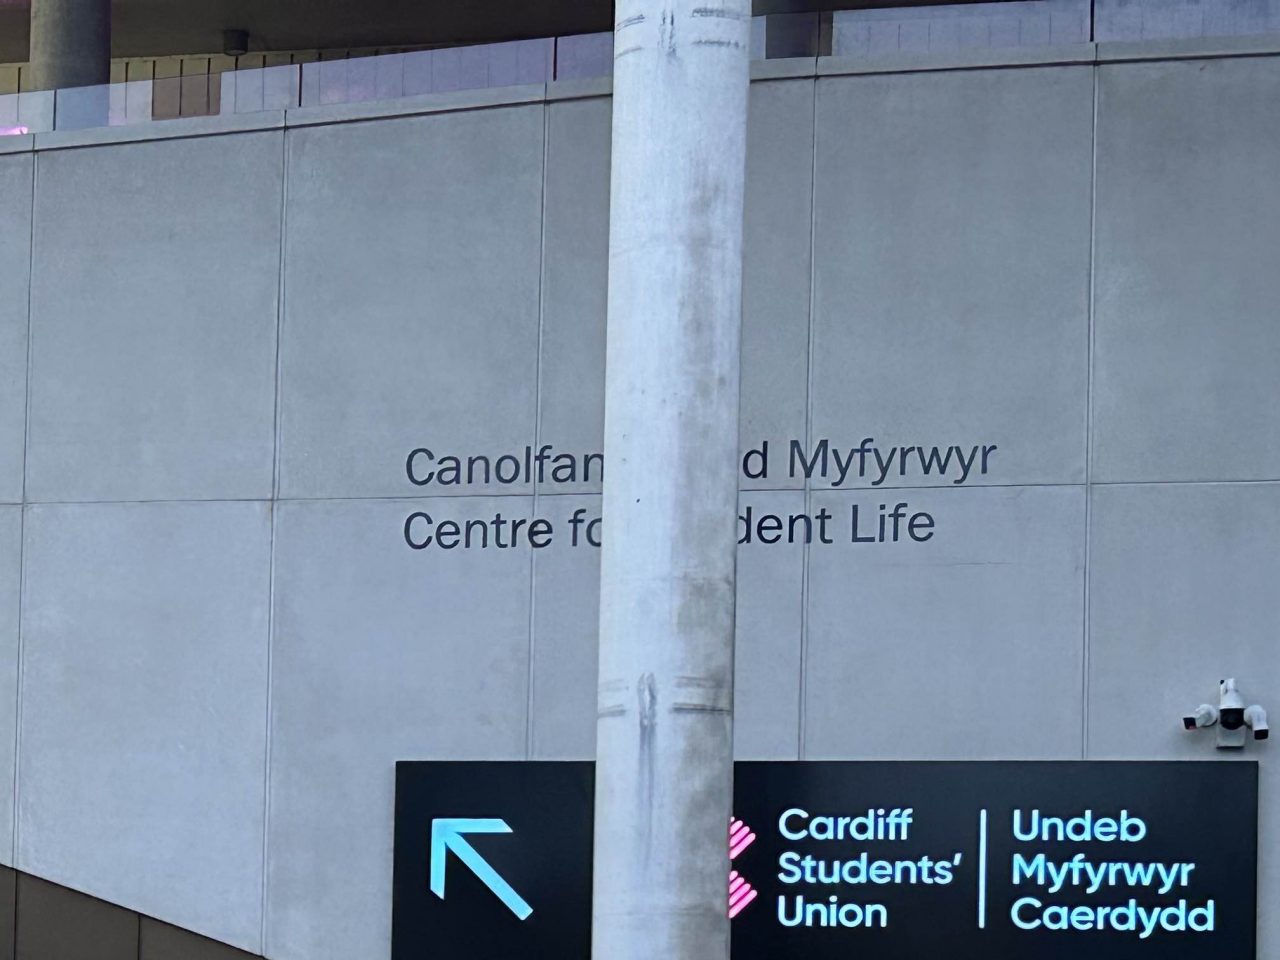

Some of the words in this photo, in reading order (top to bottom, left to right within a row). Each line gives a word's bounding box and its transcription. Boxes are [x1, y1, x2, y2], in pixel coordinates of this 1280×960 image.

[406, 445, 604, 486] Canolfan
[789, 438, 997, 487] Myfyrwyr
[404, 511, 553, 550] Centre
[568, 508, 602, 547] fo
[738, 506, 833, 544] dent
[852, 502, 935, 543] Life
[778, 808, 913, 841] Cardiff
[1013, 809, 1147, 842] Undeb
[1012, 853, 1195, 893] Myfyrwyr
[777, 895, 887, 927] Union
[1011, 897, 1215, 939] Caerdydd
